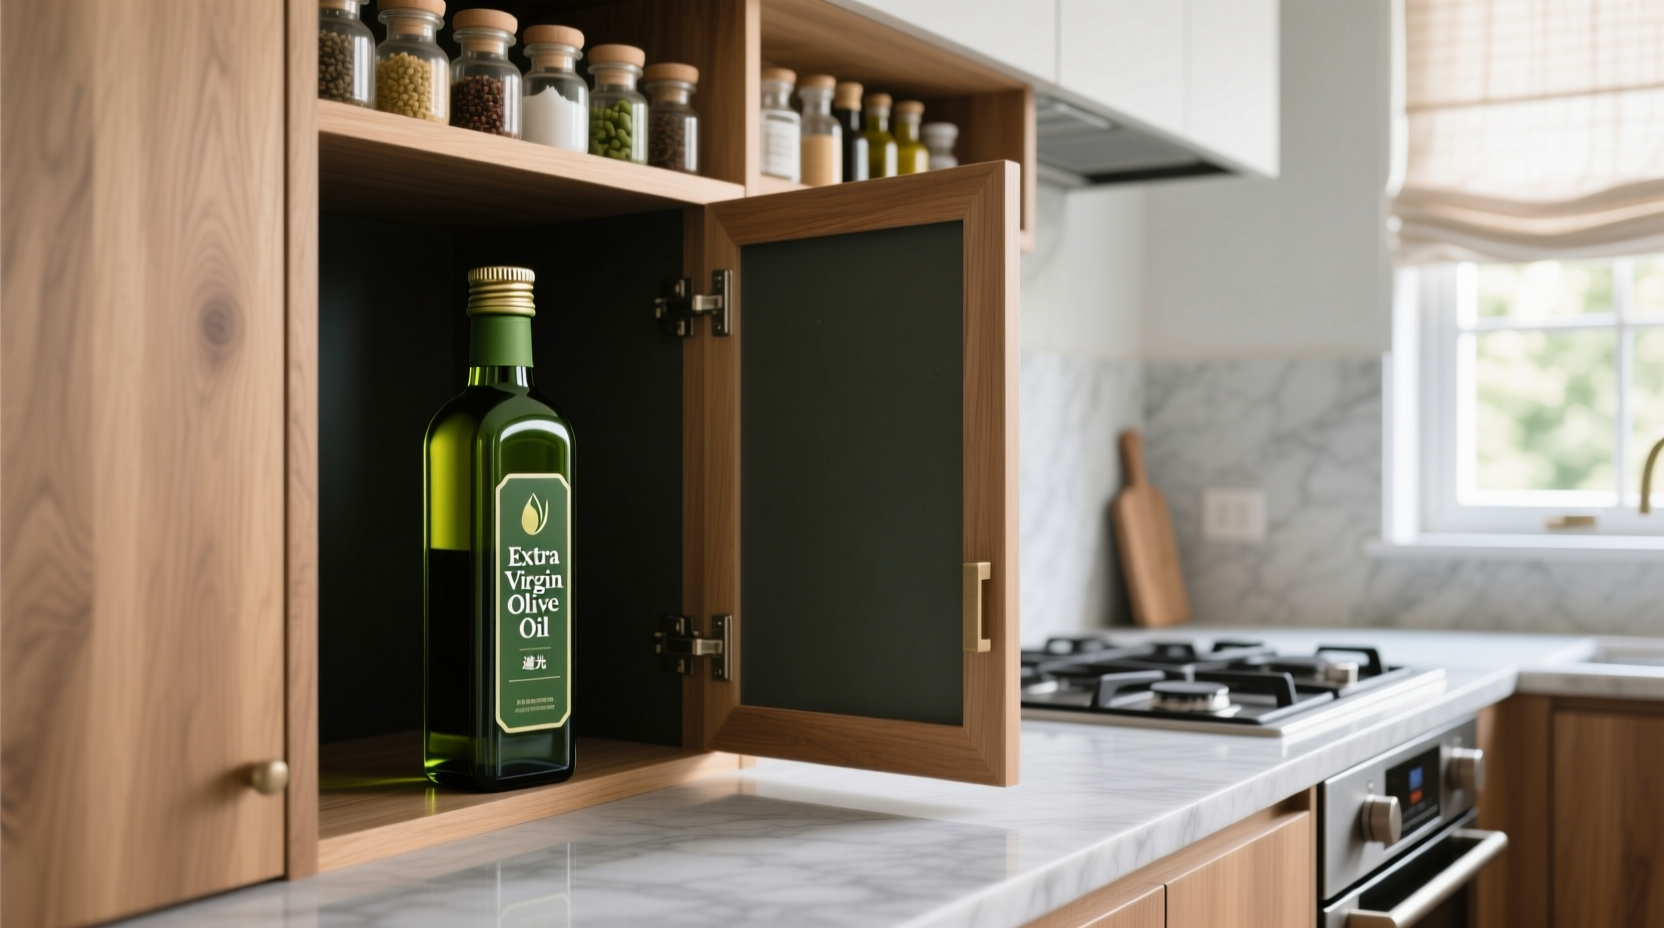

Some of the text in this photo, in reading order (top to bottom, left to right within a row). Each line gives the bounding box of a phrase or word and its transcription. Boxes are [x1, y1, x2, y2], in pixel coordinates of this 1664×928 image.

[508, 546, 560, 567] Extra
[504, 570, 564, 594] Virgin
[507, 593, 560, 615] Olive
[519, 615, 550, 638] Oil
